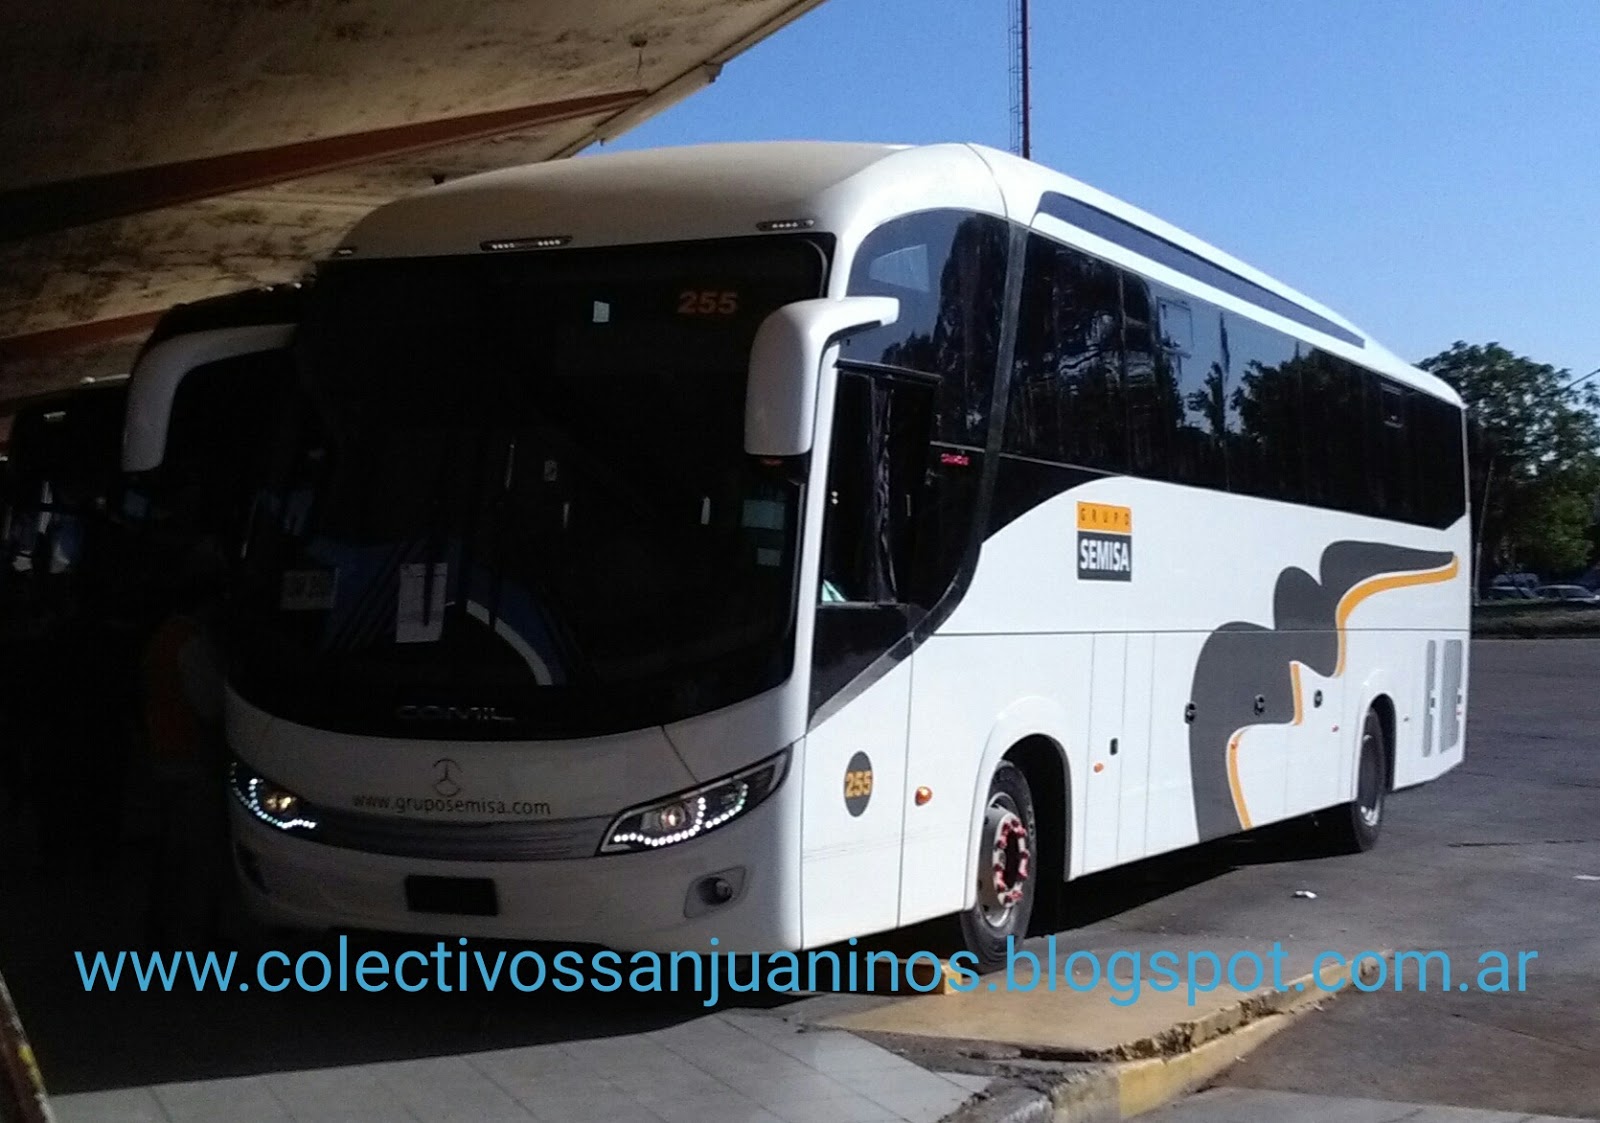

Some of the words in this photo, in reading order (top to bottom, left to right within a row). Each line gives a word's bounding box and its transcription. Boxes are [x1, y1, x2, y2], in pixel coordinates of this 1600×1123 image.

[678, 290, 737, 314] 255
[1080, 506, 1130, 526] GRUPO
[1080, 538, 1131, 572] SEMISA
[845, 770, 873, 798] 255
[353, 795, 551, 815] www.gruposemisa.com
